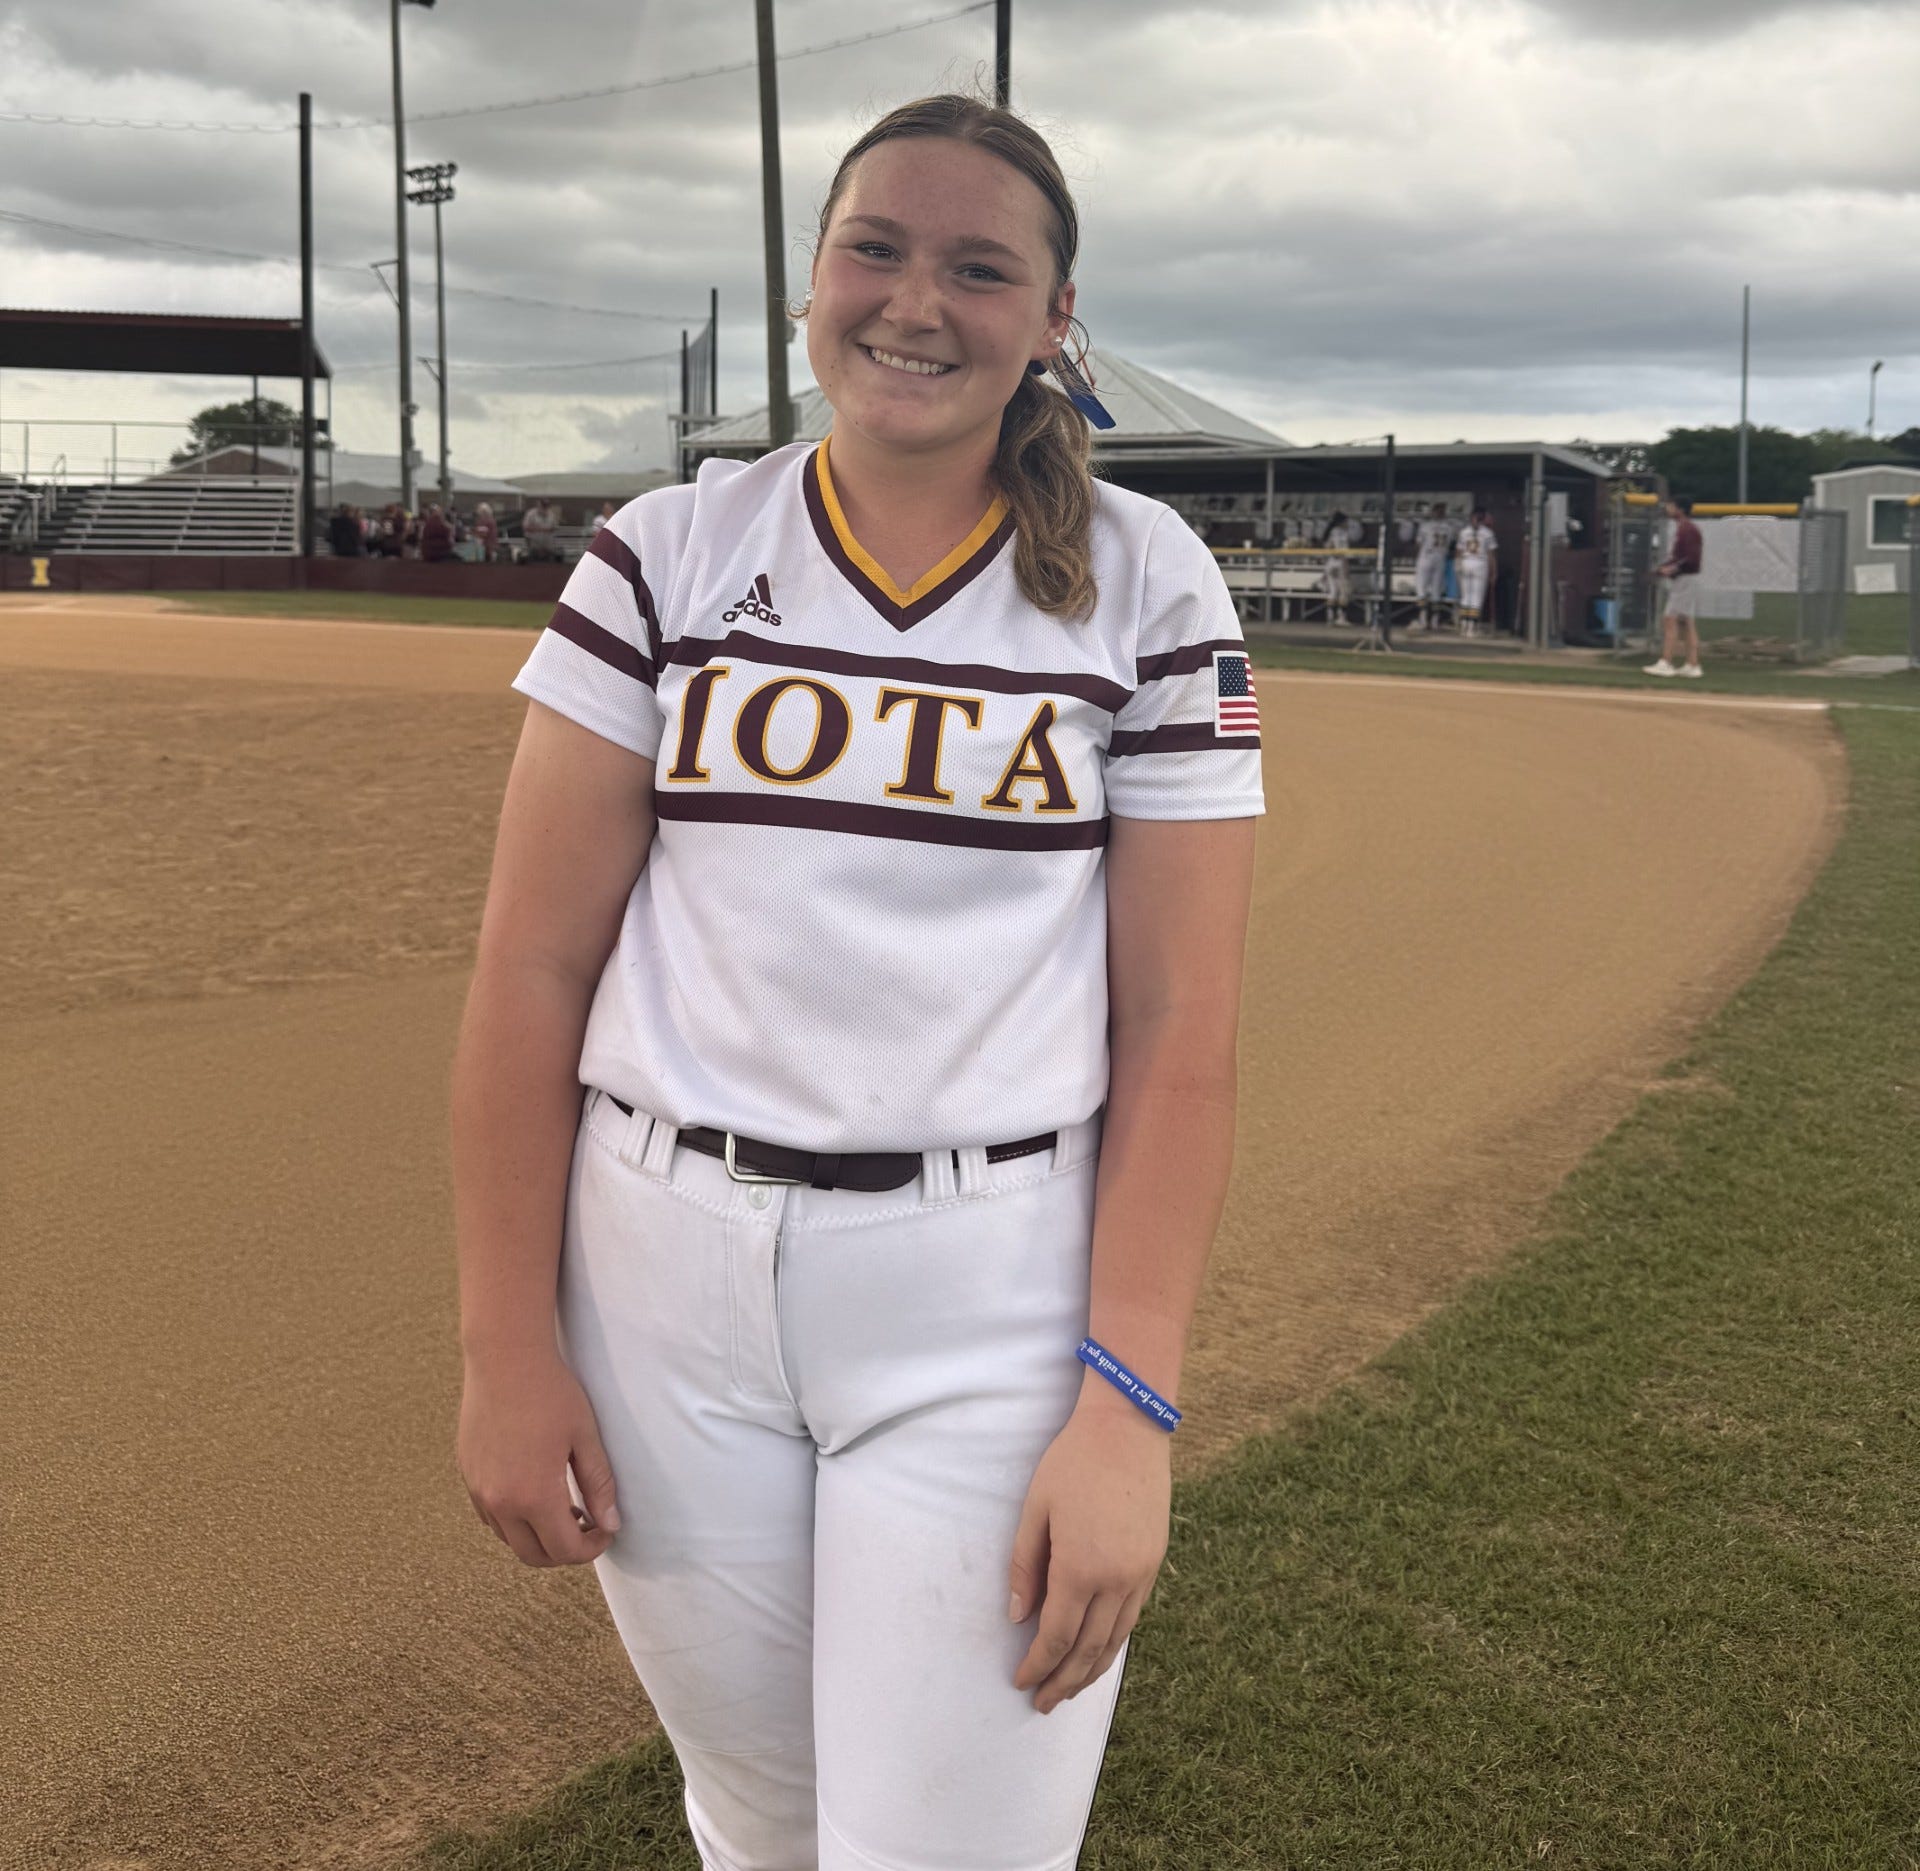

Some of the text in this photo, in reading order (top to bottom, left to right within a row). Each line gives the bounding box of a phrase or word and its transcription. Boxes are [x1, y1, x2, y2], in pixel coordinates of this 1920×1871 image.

[722, 601, 782, 626] adas
[666, 665, 1079, 814] IOTA
[1098, 1355, 1118, 1374] with
[1117, 1371, 1133, 1386] am
[1130, 1383, 1138, 1394] I
[1136, 1389, 1152, 1404] for
[1149, 1399, 1167, 1416] fear
